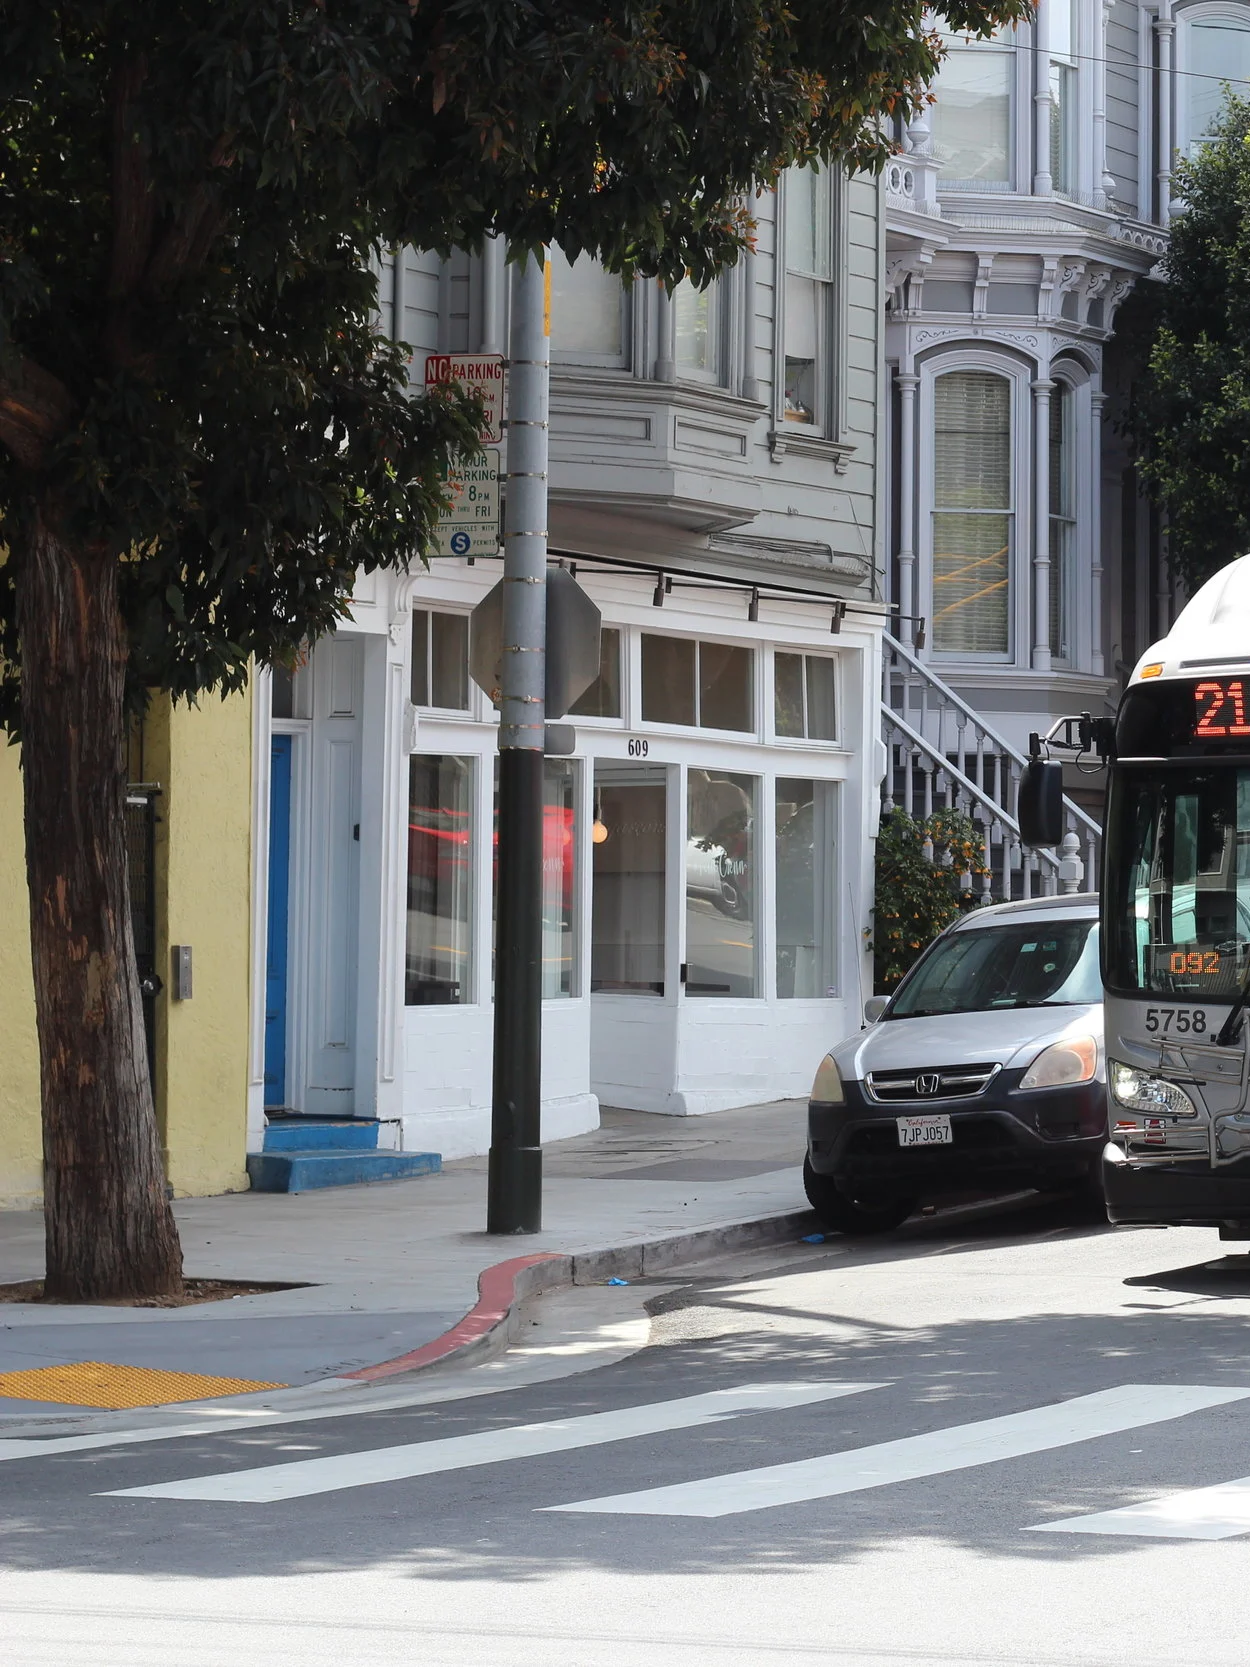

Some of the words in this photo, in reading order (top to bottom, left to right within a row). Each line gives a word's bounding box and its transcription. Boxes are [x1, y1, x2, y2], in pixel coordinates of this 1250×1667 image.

[452, 363, 501, 380] PARKING
[450, 469, 497, 482] ARKING
[468, 485, 477, 501] 8
[478, 493, 490, 501] PM
[475, 506, 491, 517] FRI
[455, 535, 467, 551] S
[628, 738, 649, 757] 609
[1170, 952, 1220, 974] 092
[1145, 1008, 1207, 1034] 5758
[901, 1125, 949, 1143] 7JPJ057
